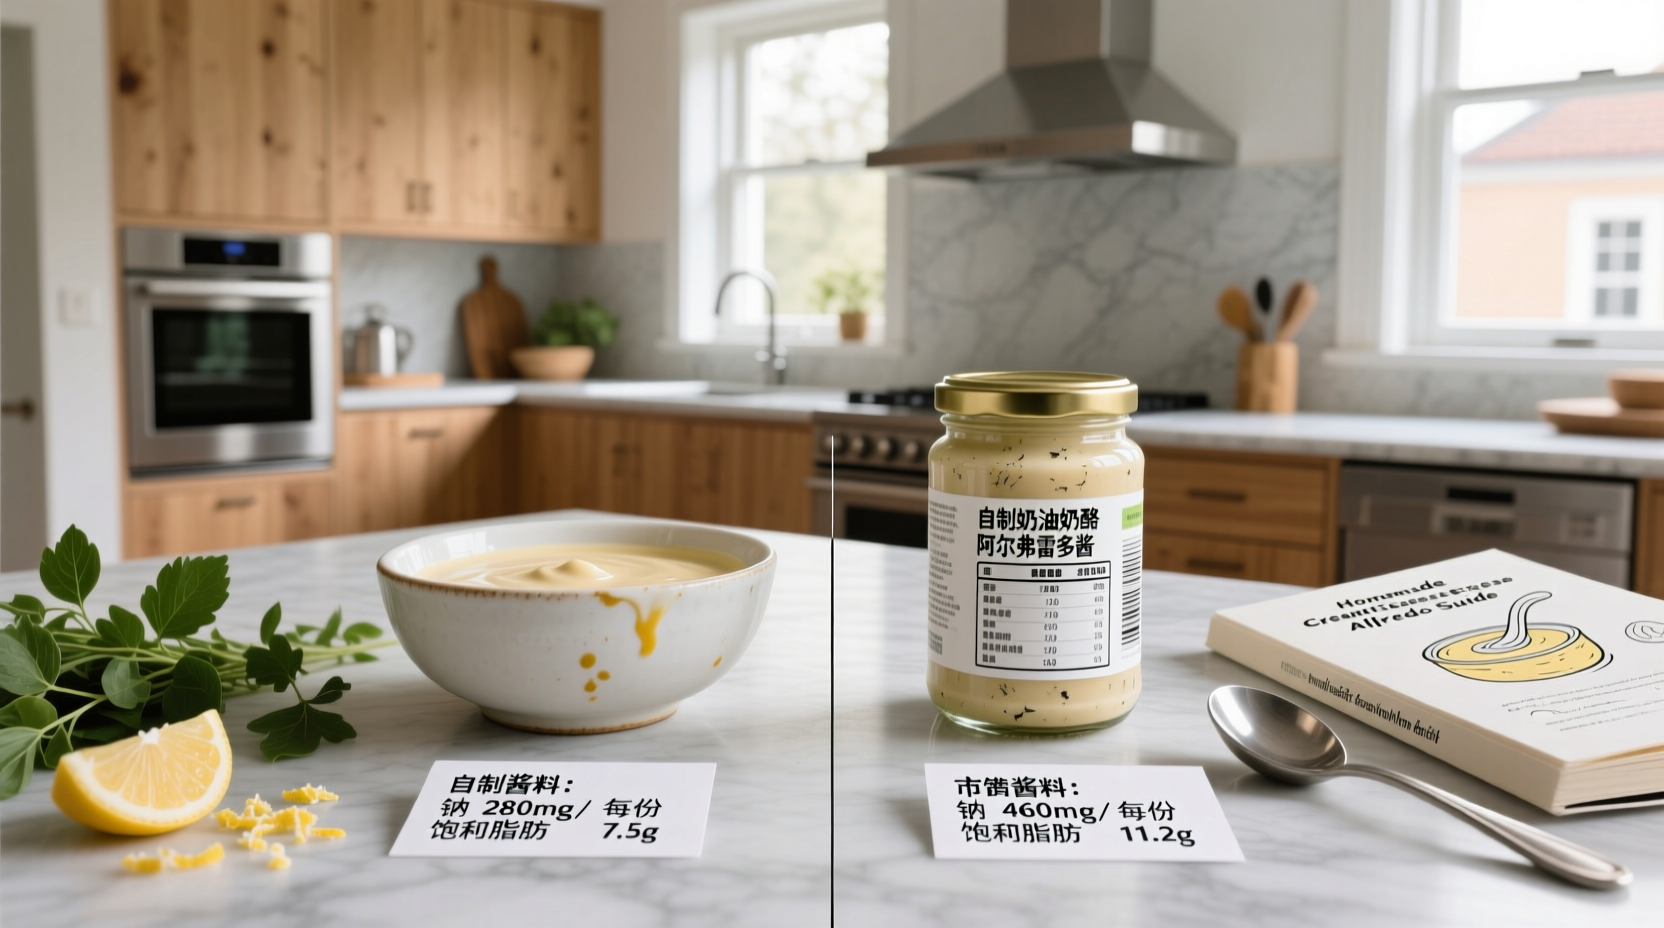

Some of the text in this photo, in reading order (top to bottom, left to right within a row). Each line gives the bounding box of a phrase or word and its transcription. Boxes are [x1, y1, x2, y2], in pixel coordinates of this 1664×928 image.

[978, 506, 1100, 531] 自制奶油奶酪
[977, 533, 1095, 558] 阿尔弗雷多酱
[441, 797, 470, 818] 钠
[603, 797, 662, 819] 每份
[957, 800, 985, 820] 钠
[1118, 800, 1176, 821] 每份
[431, 819, 660, 844] 饱和脂肪 7.5g
[961, 821, 1196, 847] 饱和脂肪 11.2g
